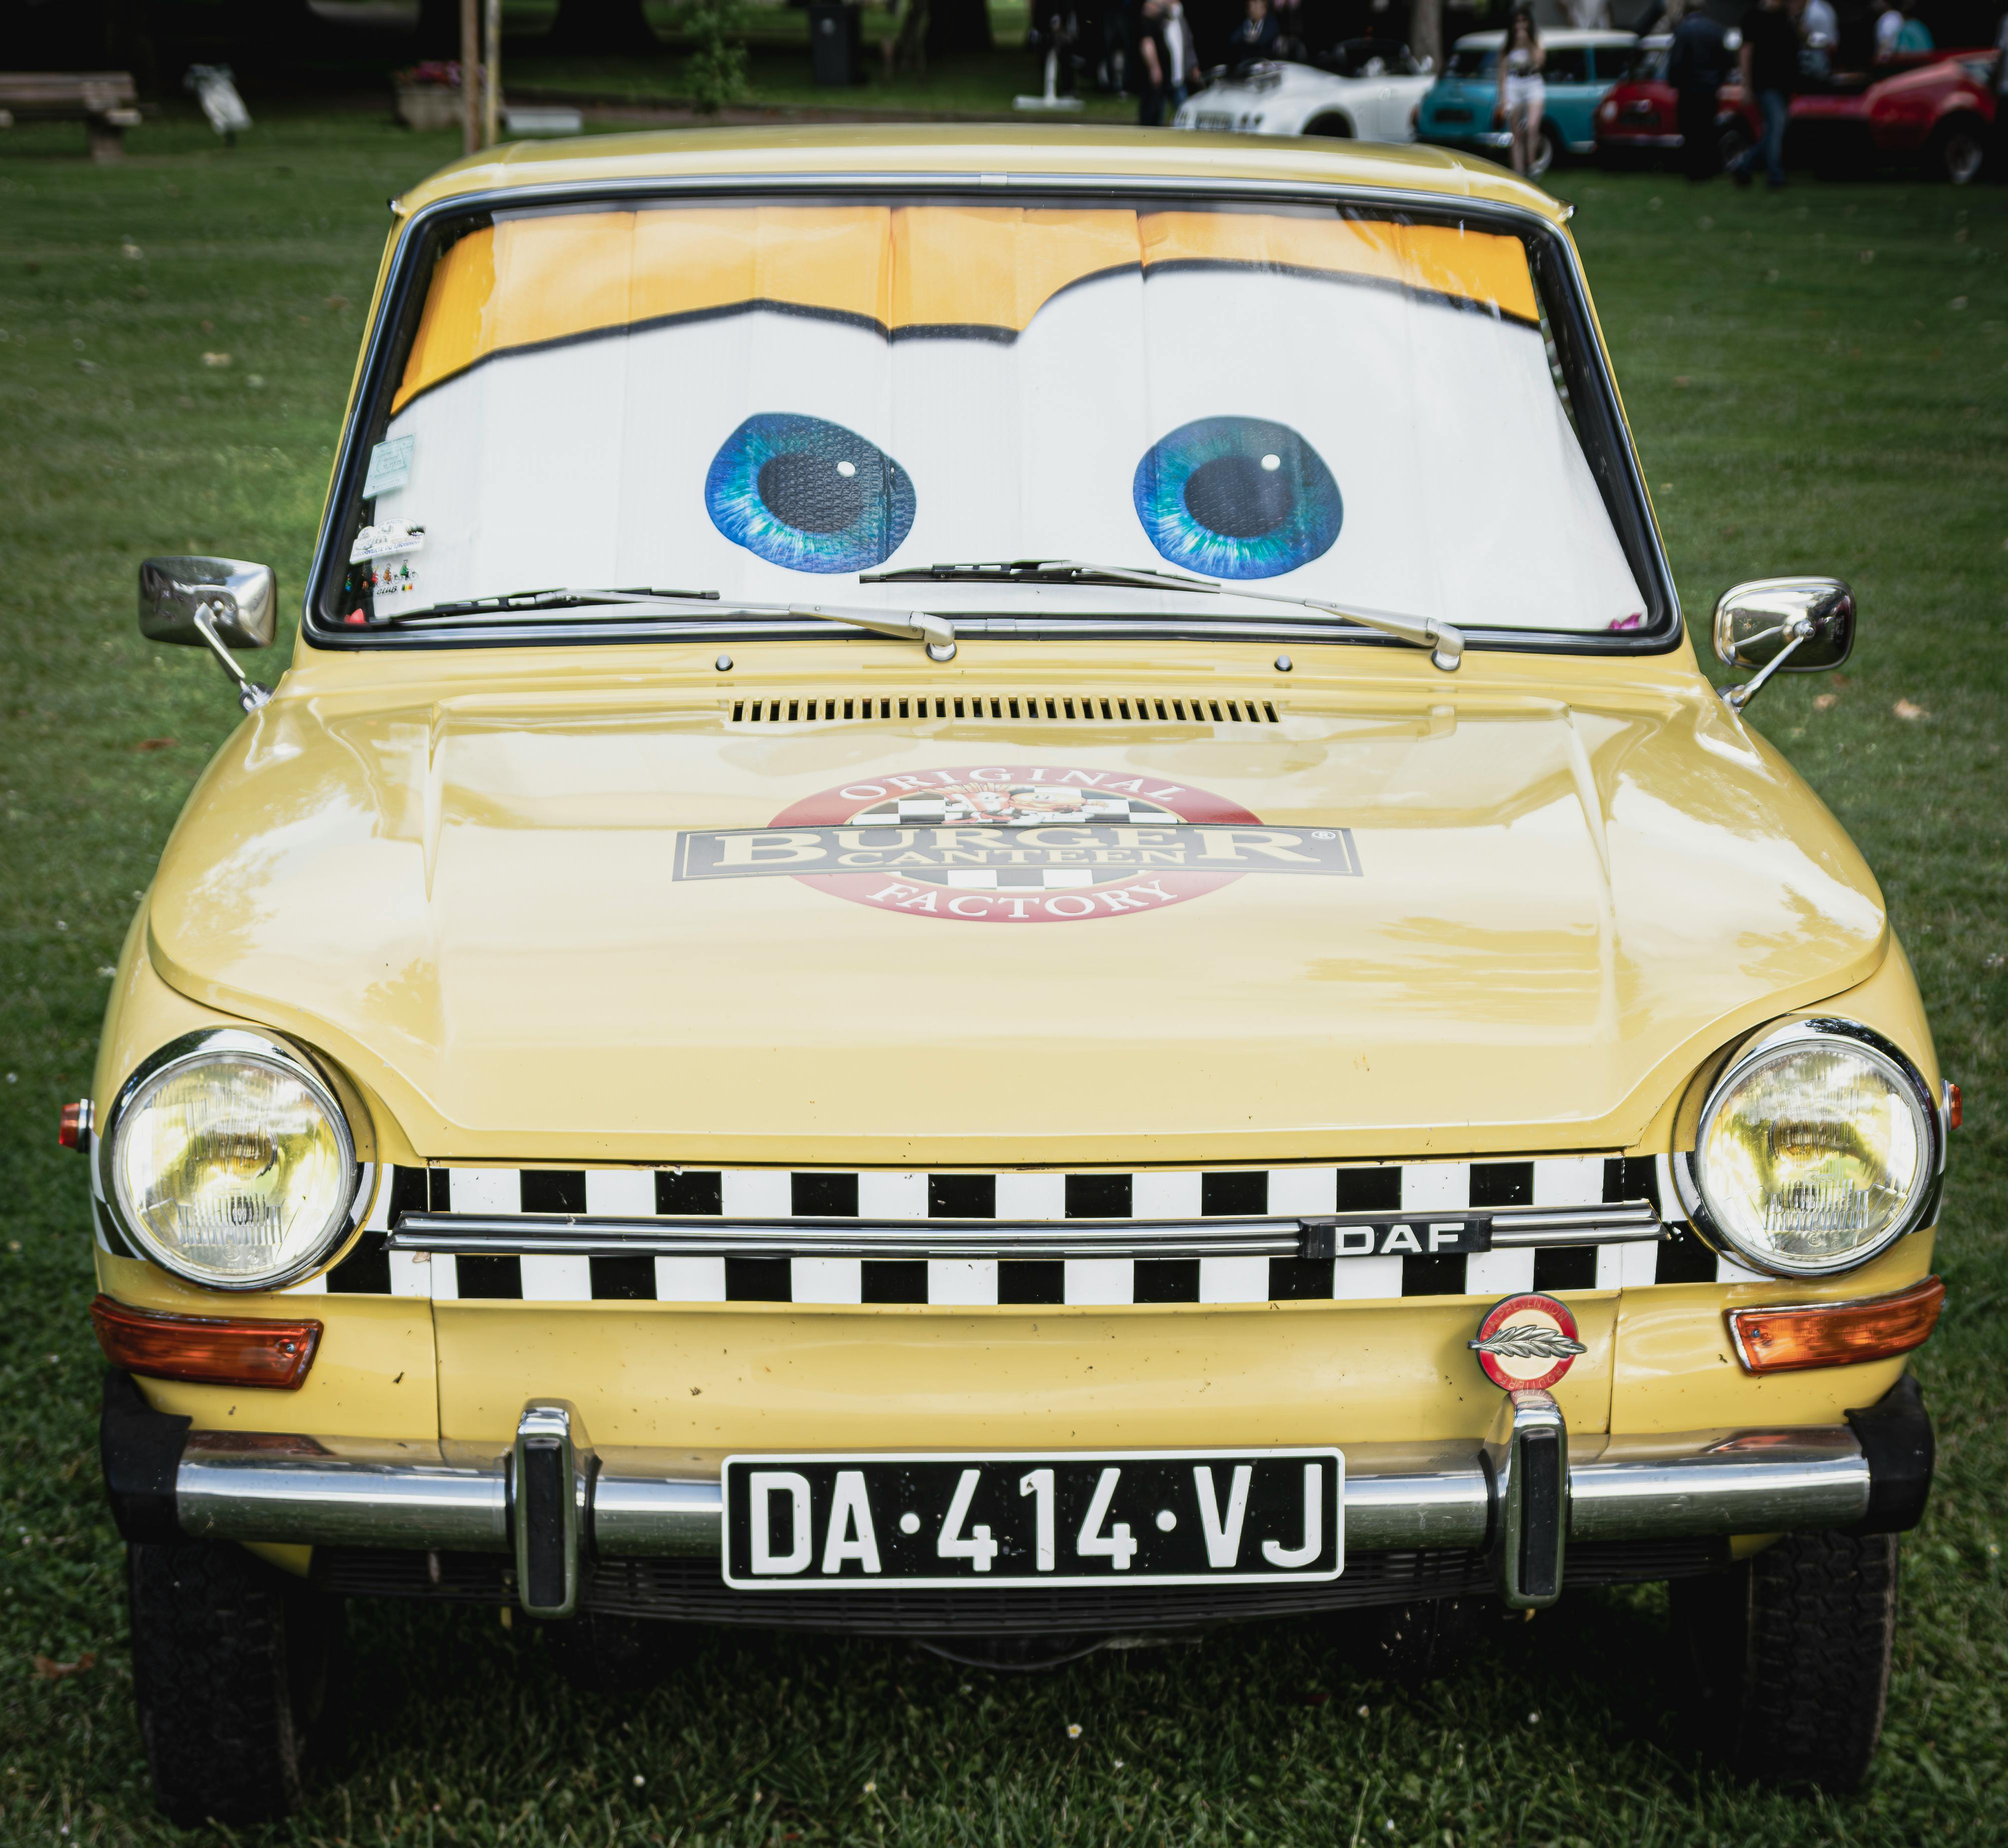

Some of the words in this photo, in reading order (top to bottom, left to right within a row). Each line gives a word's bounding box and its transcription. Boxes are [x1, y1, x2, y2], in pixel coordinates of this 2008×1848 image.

[839, 767, 1186, 801] ORIGINAL
[712, 827, 1321, 867] BURGER
[837, 849, 1188, 865] CANTEEN
[866, 879, 1178, 918] FACTORY
[1335, 1222, 1465, 1256] DAF
